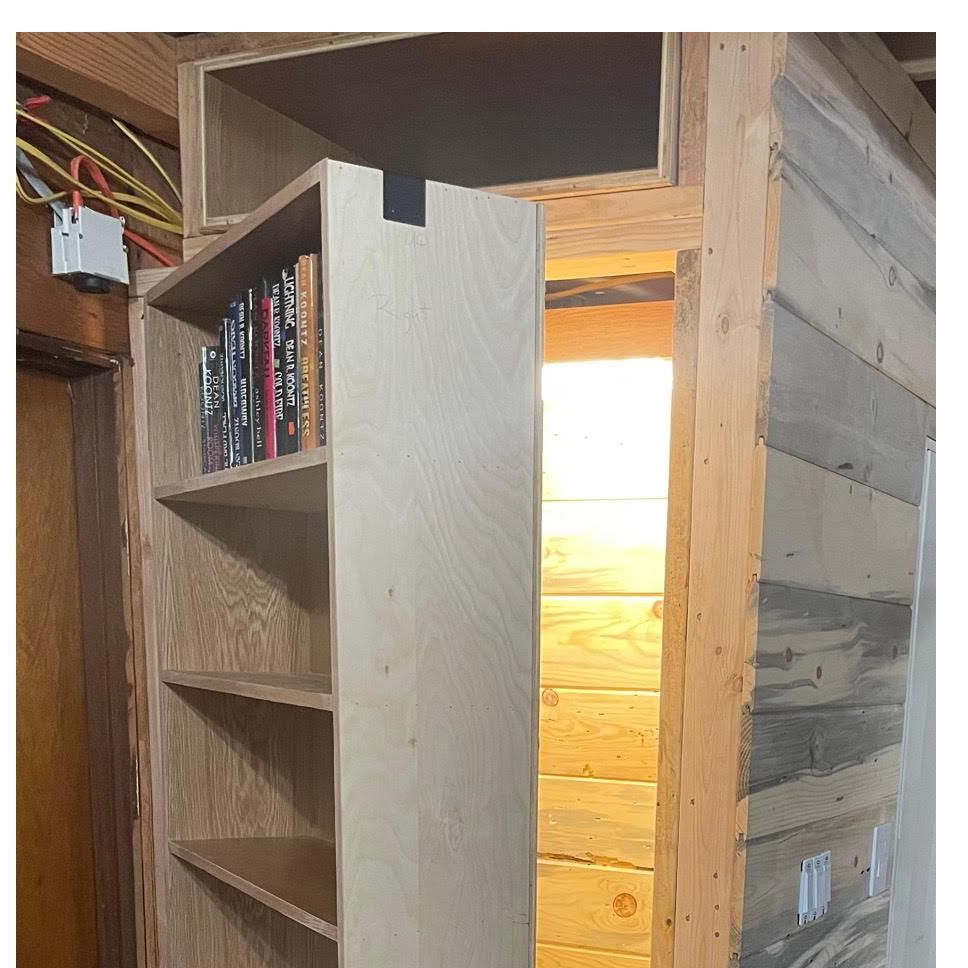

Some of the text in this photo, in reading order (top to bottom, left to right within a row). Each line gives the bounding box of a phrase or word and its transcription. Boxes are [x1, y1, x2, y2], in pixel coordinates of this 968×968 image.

[272, 283, 280, 309] DEAN
[282, 271, 296, 330] LIGHTNING
[273, 315, 281, 348] KOONTZ
[299, 291, 308, 345] KOONTZ
[285, 339, 295, 365] DEAN
[205, 368, 214, 416] KOONTZ
[212, 376, 221, 409] DEAN
[274, 371, 282, 397] COLD
[286, 372, 296, 407] KOONTZ
[300, 356, 310, 437] BREATHLESS
[318, 383, 326, 440] KOONTZ
